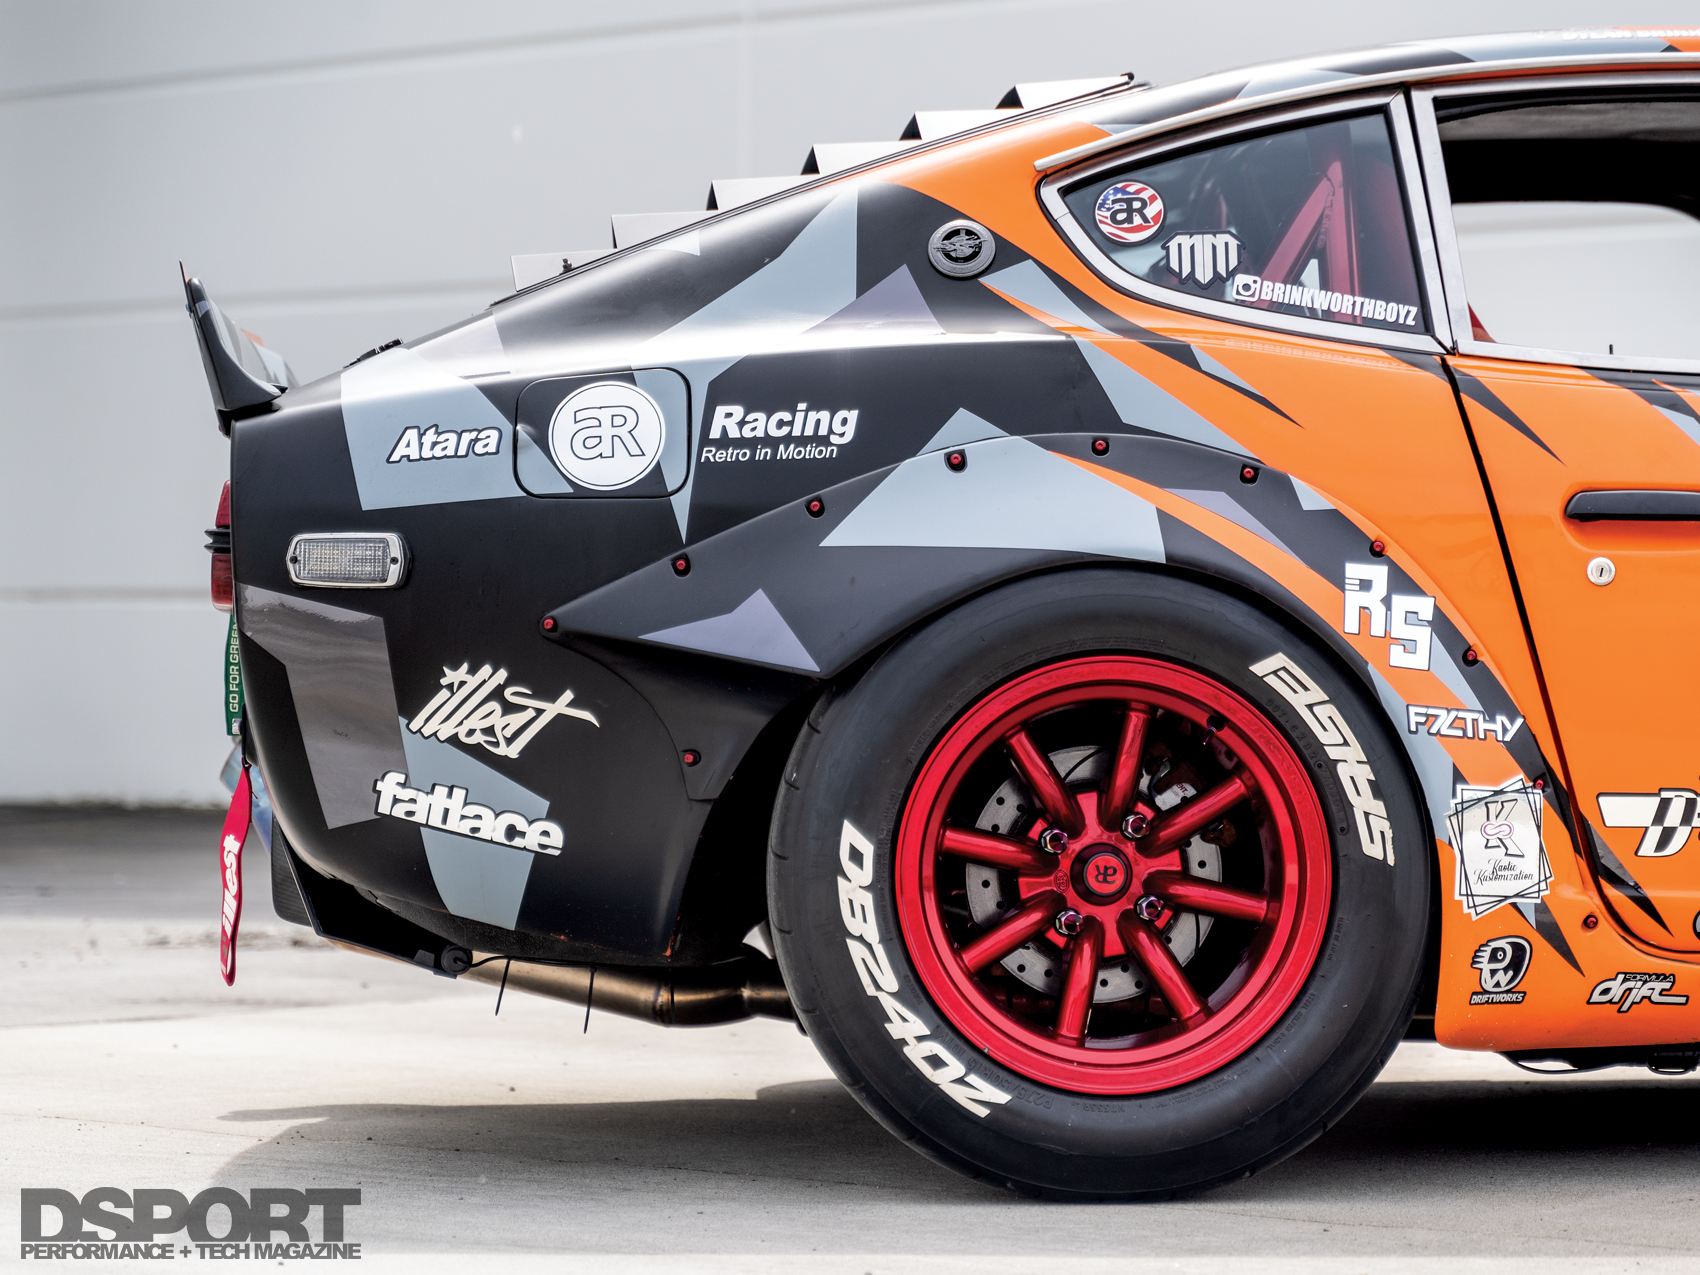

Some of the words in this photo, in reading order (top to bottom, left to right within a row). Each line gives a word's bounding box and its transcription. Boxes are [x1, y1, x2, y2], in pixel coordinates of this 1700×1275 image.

[1260, 280, 1418, 327] BRINKWORTHBOYZ
[709, 402, 859, 444] Racing
[388, 424, 500, 462] Atara
[701, 446, 750, 463] Retro
[755, 444, 772, 461] in
[781, 444, 838, 461] Motion
[229, 664, 239, 691] FOR
[229, 693, 239, 713] GO
[376, 772, 564, 856] fatlace
[1470, 992, 1524, 1004] DRIFTWORKS
[1589, 973, 1687, 1012] drift
